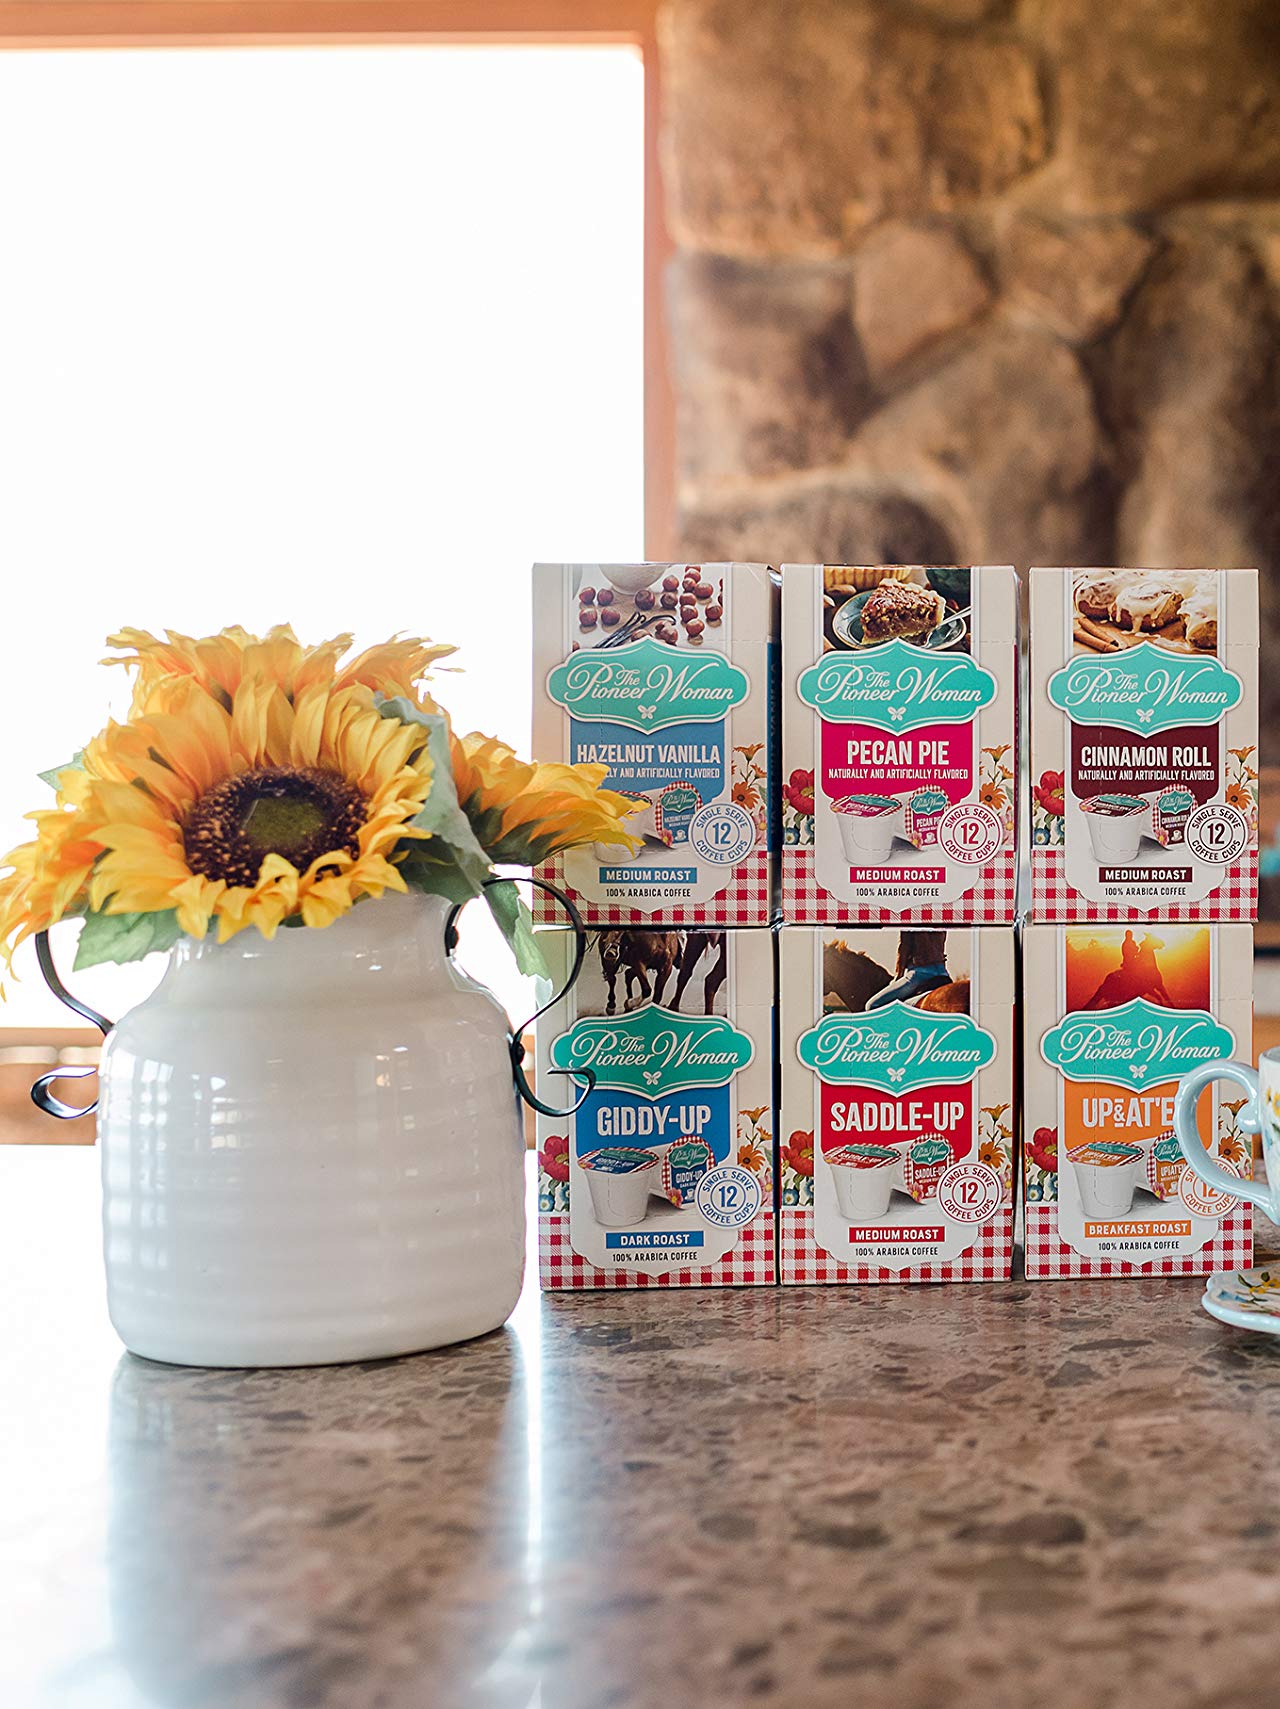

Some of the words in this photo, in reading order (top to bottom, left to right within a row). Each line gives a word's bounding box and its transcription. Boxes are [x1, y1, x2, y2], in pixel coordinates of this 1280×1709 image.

[564, 661, 650, 702] Pioneer
[614, 669, 640, 686] The
[647, 663, 734, 703] Woman
[815, 663, 899, 704] Pioneer
[865, 671, 890, 688] The
[896, 664, 982, 704] Woman
[1065, 666, 1148, 706] Pioneer
[1114, 674, 1138, 690] The
[1145, 667, 1228, 706] Woman
[577, 744, 654, 763] HAZELNUT
[657, 745, 721, 764] VANILLA
[847, 740, 912, 765] PECAN
[918, 740, 949, 765] PIE
[1081, 746, 1167, 767] CINNAMON
[1172, 746, 1211, 767] ROLL
[620, 767, 634, 778] AND
[636, 767, 682, 778] ARTIFICIALLY
[684, 767, 720, 778] FLAVORED
[828, 768, 868, 779] NATURALLY
[870, 768, 884, 779] AND
[886, 768, 932, 779] ARTIFICIALLY
[934, 768, 968, 779] FLAVORED
[1078, 770, 1117, 780] NATURALLY
[1119, 770, 1133, 780] AND
[1135, 770, 1179, 780] ARTIFICIALLY
[1181, 770, 1215, 780] FLAVORED
[696, 808, 721, 829] SINGLE
[725, 808, 748, 829] SERVE
[944, 808, 970, 829] SINGLE
[973, 808, 996, 829] SERVE
[1192, 808, 1216, 829] SINGLE
[1218, 808, 1241, 829] SERVE
[712, 823, 731, 845] 12
[960, 823, 979, 845] 12
[1207, 823, 1225, 845] 12
[696, 839, 724, 861] COFFEE
[727, 839, 748, 861] CUPS
[944, 839, 972, 861] COFFEE
[975, 839, 996, 860] CUPS
[1191, 839, 1218, 861] COFFEE
[1221, 839, 1241, 860] CUPS
[606, 870, 653, 881] MEDIUM
[655, 870, 691, 881] ROAST
[856, 870, 903, 881] MEDIUM
[905, 870, 939, 881] ROAST
[1105, 870, 1149, 880] MEDIUM
[1151, 870, 1187, 880] ROAST
[606, 888, 626, 898] 100%
[627, 888, 662, 897] ARABICA
[664, 888, 691, 897] COFFEE
[856, 888, 875, 897] 100%
[877, 888, 910, 897] ARABICA
[912, 888, 939, 897] COFFEE
[1105, 887, 1123, 896] 100%
[1126, 887, 1158, 896] ARABICA
[1160, 887, 1186, 896] COFFEE
[620, 1036, 644, 1053] The
[651, 1028, 739, 1069] Woman
[814, 1025, 900, 1066] Pioneer
[864, 1032, 889, 1050] The
[896, 1025, 981, 1066] Woman
[1058, 1024, 1141, 1063] Pioneer
[1107, 1029, 1132, 1047] The
[1138, 1022, 1221, 1063] Woman
[569, 1029, 654, 1069] Pioneer
[597, 1105, 711, 1136] GIDDY-UP
[830, 1102, 964, 1132] SADDLE-UP
[1082, 1096, 1174, 1128] UP&AT'E
[702, 1171, 728, 1192] SINGLE
[731, 1170, 755, 1191] SERVE
[944, 1167, 969, 1188] SINGLE
[972, 1167, 995, 1188] SERVE
[719, 1185, 737, 1207] 12
[960, 1182, 978, 1204] 12
[1185, 1193, 1212, 1213] COFFEE
[703, 1203, 731, 1224] COFFEE
[734, 1202, 755, 1222] CUPS
[943, 1198, 972, 1220] COFFEE
[974, 1198, 995, 1218] CUPS
[855, 1230, 900, 1240] MEDIUM
[903, 1229, 939, 1240] ROAST
[1089, 1224, 1151, 1235] BREAKFAST
[1152, 1223, 1188, 1234] ROAST
[620, 1235, 652, 1246] DARK
[653, 1234, 690, 1245] ROAST
[1098, 1242, 1117, 1251] 100%
[1119, 1241, 1152, 1250] ARABICA
[1154, 1241, 1179, 1249] COFFEE
[612, 1253, 632, 1262] 100%
[634, 1252, 669, 1261] ARABICA
[671, 1251, 698, 1261] COFFEE
[855, 1248, 874, 1256] 100%
[876, 1247, 910, 1256] ARABICA
[912, 1247, 938, 1256] COFFEE
